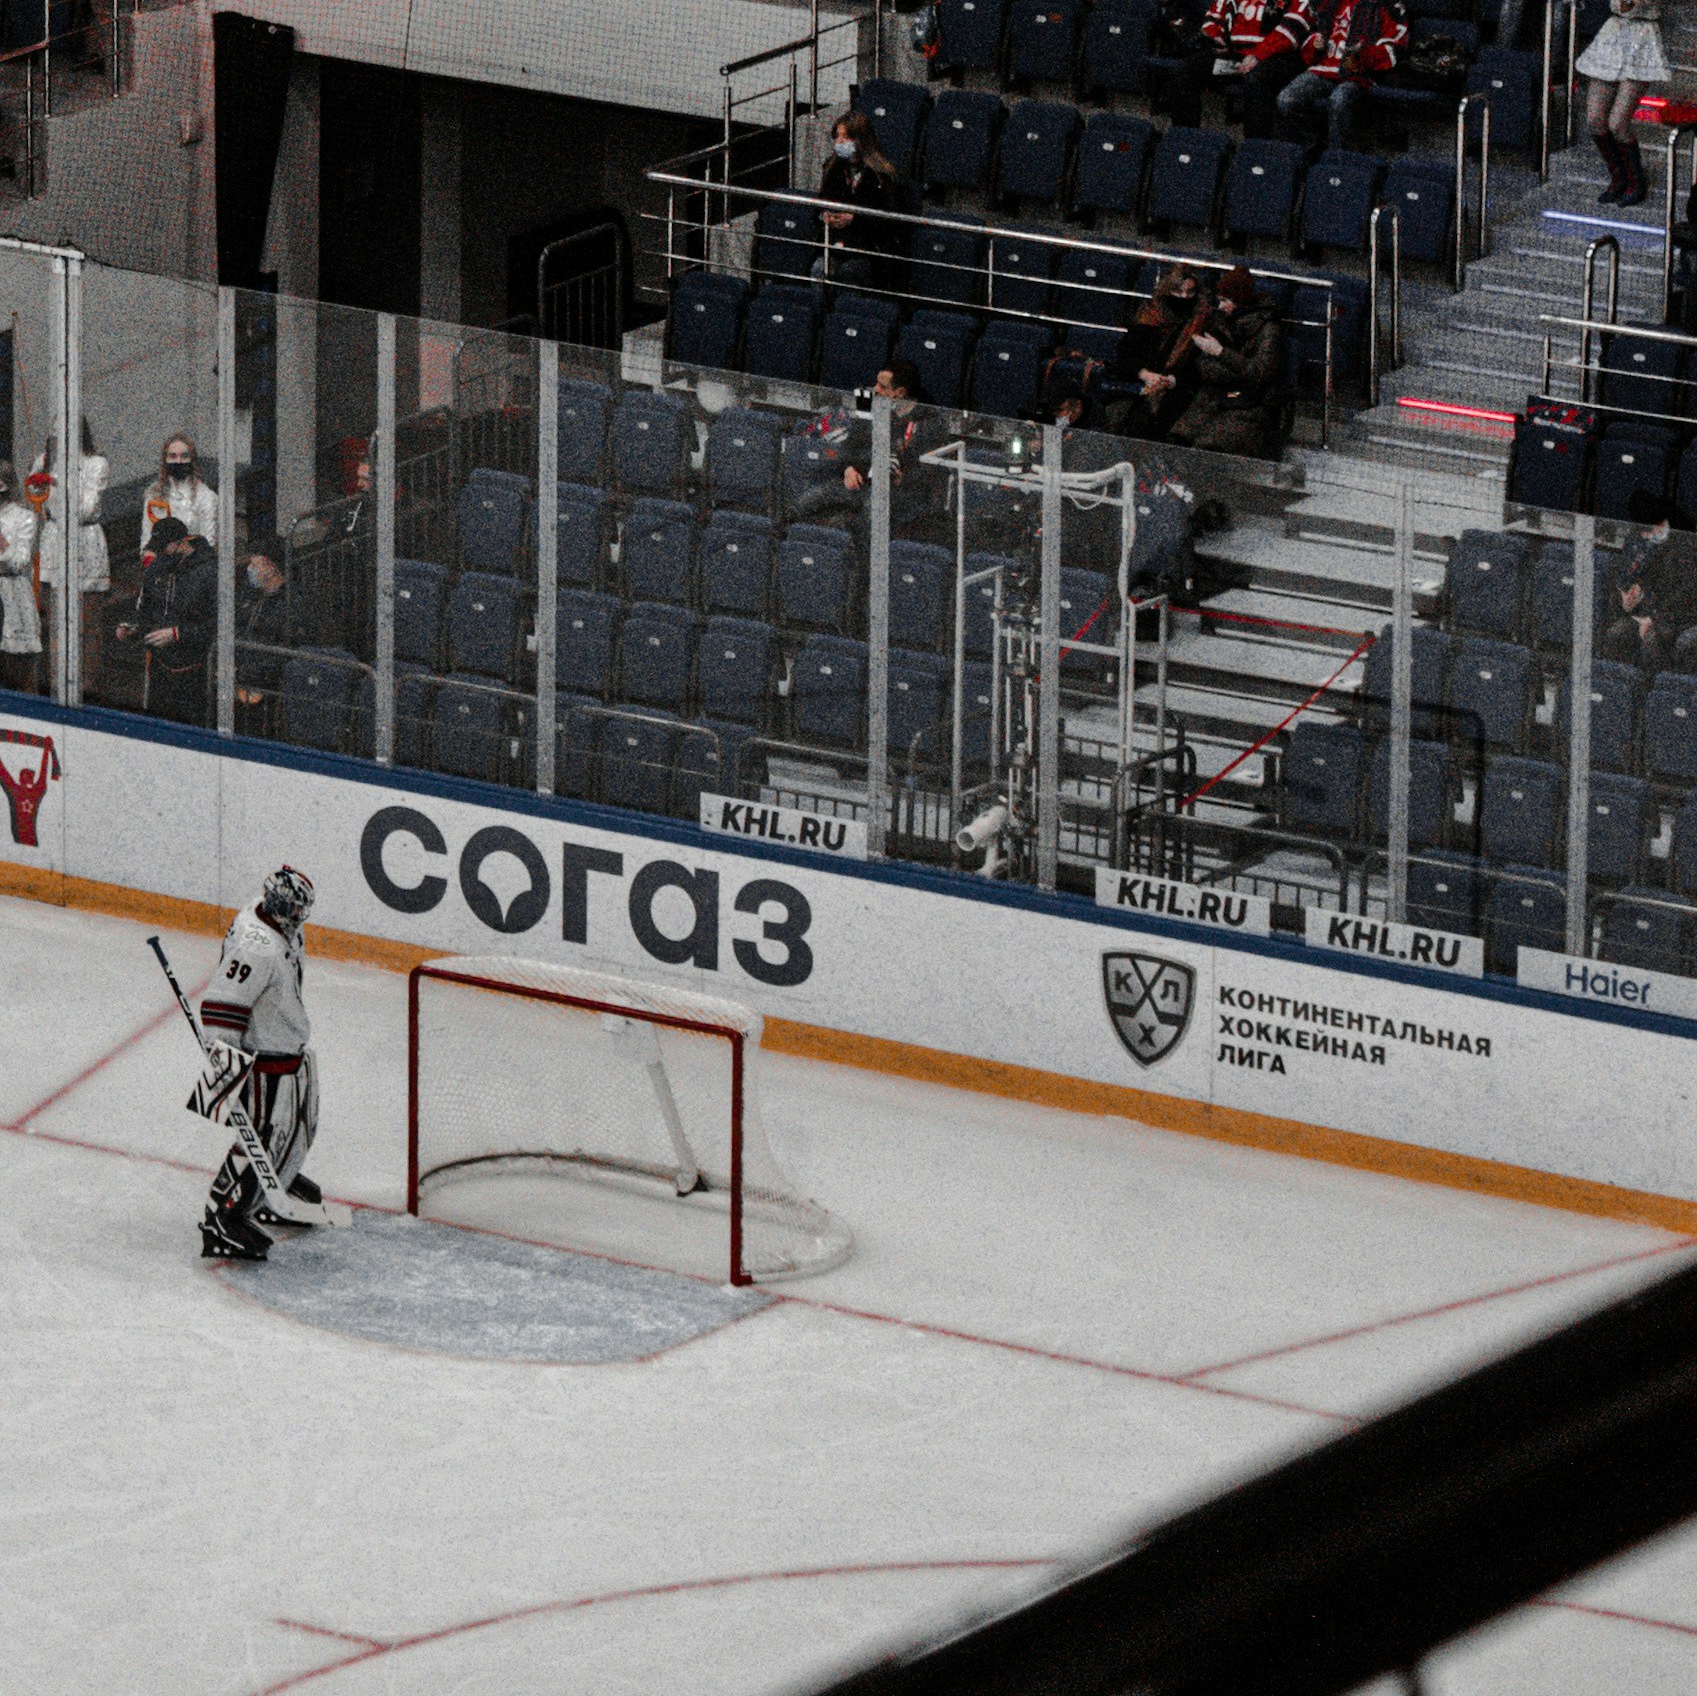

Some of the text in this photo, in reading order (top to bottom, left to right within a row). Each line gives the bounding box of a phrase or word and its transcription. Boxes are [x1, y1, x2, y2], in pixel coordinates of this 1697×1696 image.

[720, 802, 847, 851] KHL.RU
[1116, 875, 1248, 928] KHL.RU
[1327, 915, 1462, 968] KHL.RU
[226, 959, 253, 984] 39
[1564, 962, 1651, 1005] Haier
[1218, 1013, 1387, 1066] ХОККЕЙНАЯ
[1219, 985, 1492, 1058] КОНТИНЕНТАЛЬНАЯ
[1217, 1043, 1287, 1075] ЛИГА
